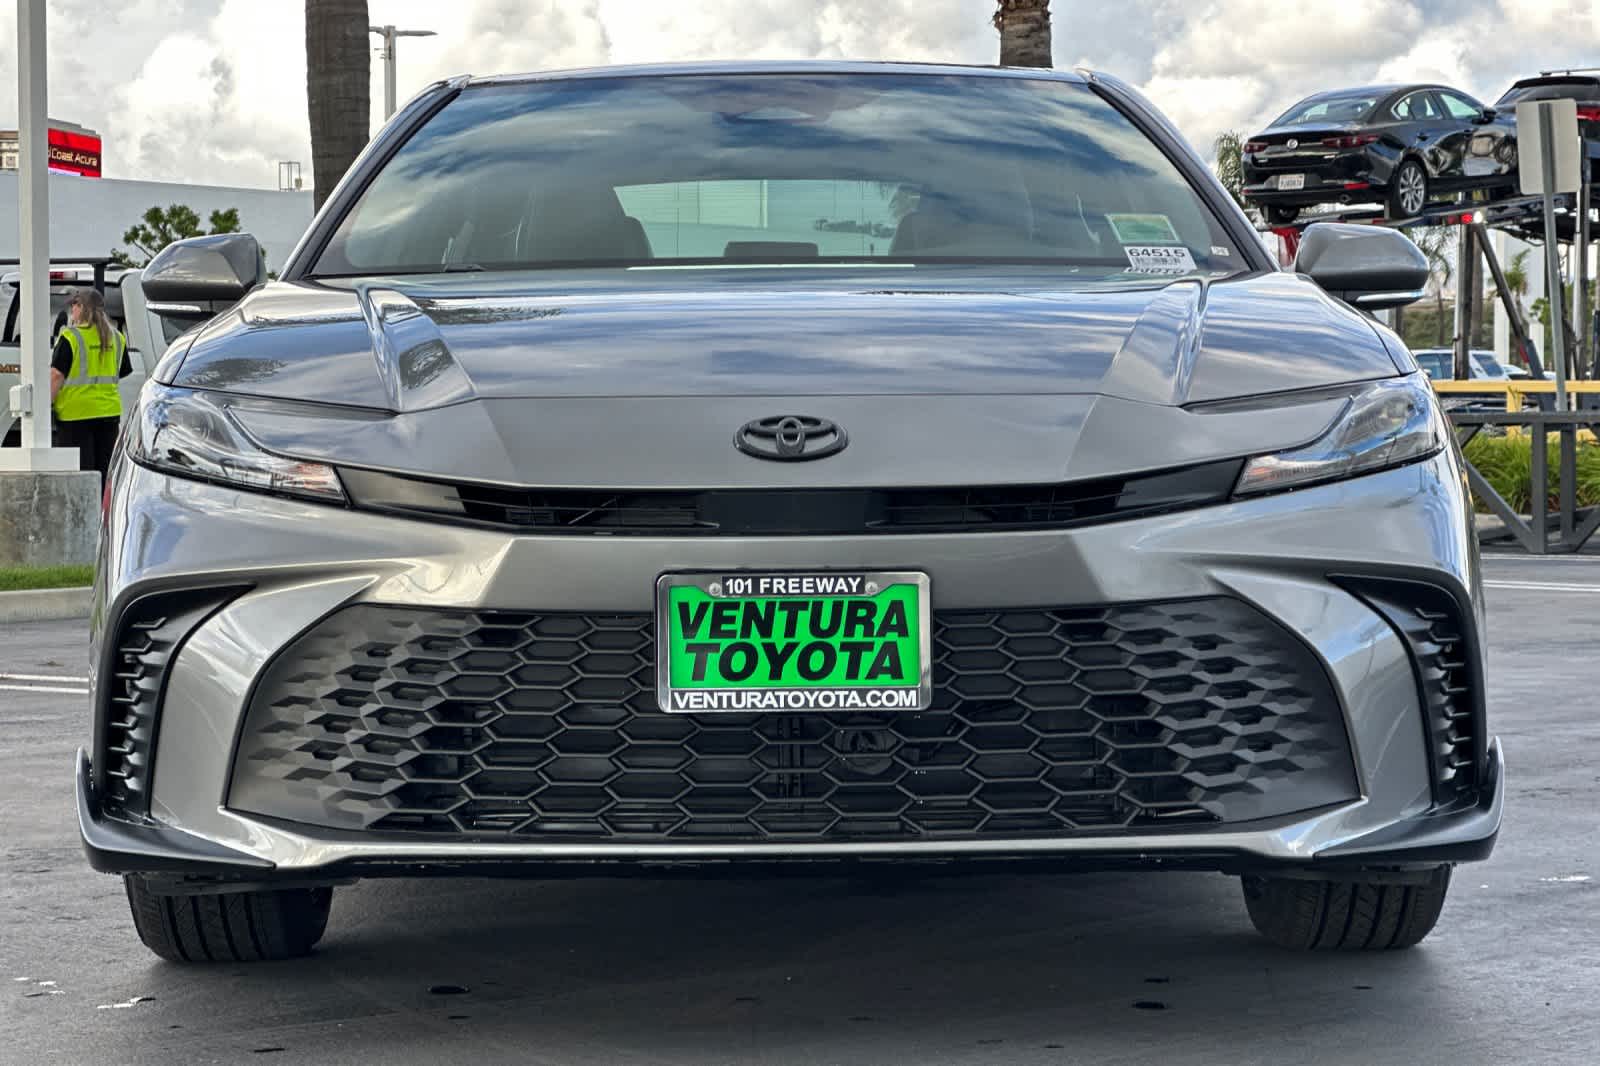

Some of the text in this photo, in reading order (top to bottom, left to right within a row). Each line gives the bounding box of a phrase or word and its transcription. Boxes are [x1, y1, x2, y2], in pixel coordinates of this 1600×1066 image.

[52, 148, 73, 162] Coast
[75, 154, 97, 167] Acura
[1128, 248, 1186, 257] 64515
[726, 577, 861, 594] 101 FREEWAY
[678, 600, 909, 639] VENTURA
[685, 641, 904, 681] TOYOTA
[674, 690, 917, 709] VENTURATOYOTA.COM
